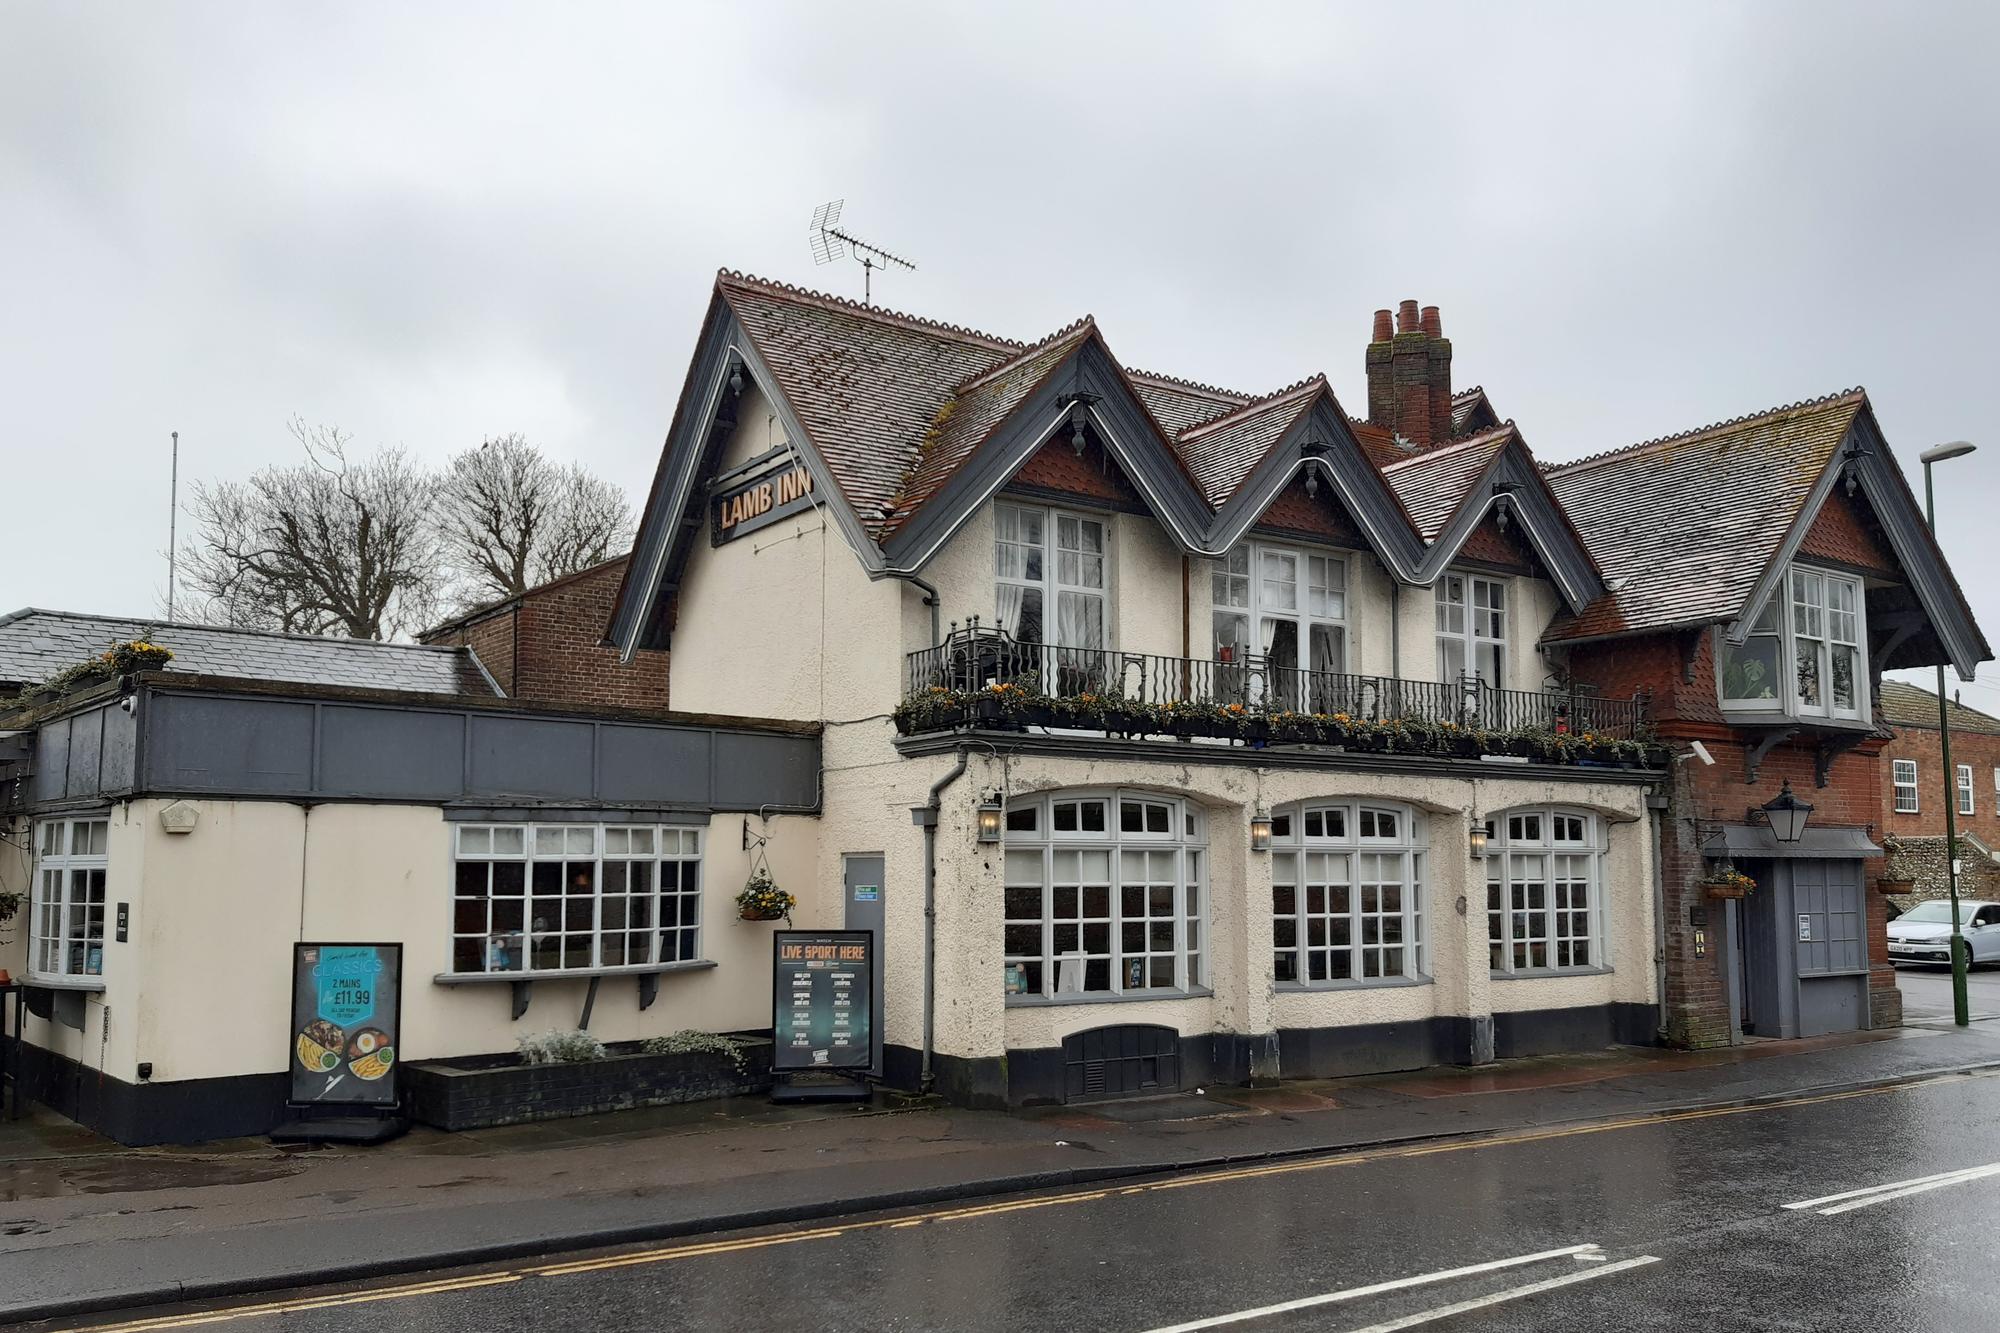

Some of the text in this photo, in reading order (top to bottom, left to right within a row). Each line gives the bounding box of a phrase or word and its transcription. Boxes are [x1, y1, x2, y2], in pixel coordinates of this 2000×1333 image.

[721, 466, 813, 530] LAMB INN
[781, 945, 865, 959] LIVE SPORT HERE
[312, 960, 383, 977] CLASSICS
[332, 979, 361, 988] 2 MAINS
[335, 990, 370, 1005] £11.99
